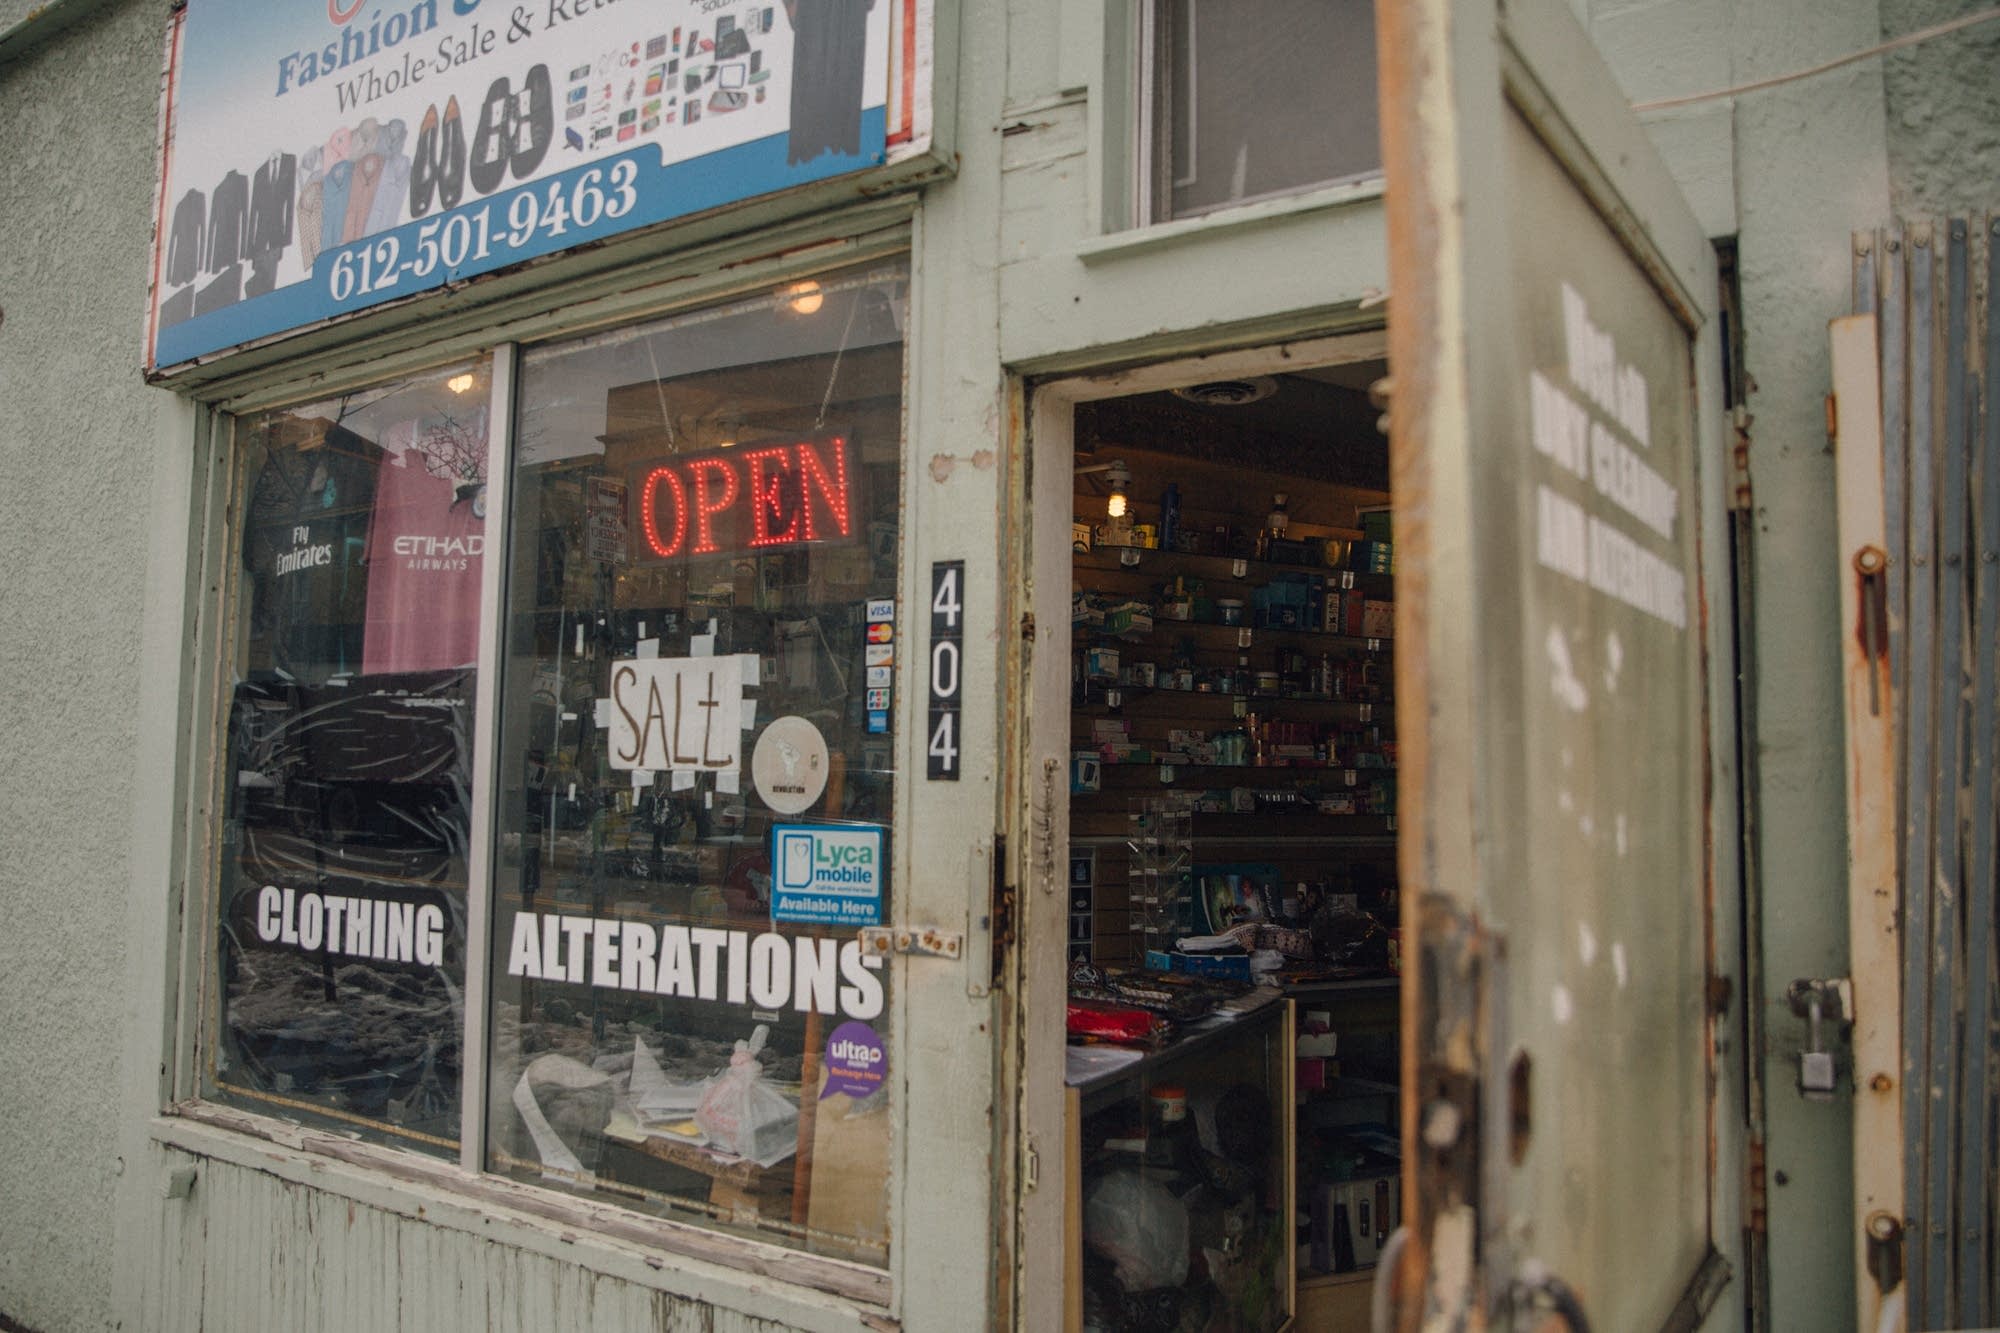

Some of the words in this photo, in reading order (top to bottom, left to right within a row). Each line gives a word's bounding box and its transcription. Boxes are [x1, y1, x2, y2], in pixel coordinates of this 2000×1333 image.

[275, 0, 438, 97] Fashion
[335, 23, 496, 114] Whole-Sale
[507, 6, 534, 43] &
[330, 158, 638, 301] 612-501-9463
[642, 436, 850, 557] OPEN
[276, 543, 332, 576] Emirates
[293, 525, 310, 545] Fly
[394, 535, 485, 556] ETIHAD
[407, 559, 468, 571] AIRWAYS
[870, 605, 892, 617] VISA
[929, 568, 961, 771] 404
[613, 666, 733, 768] SALE
[816, 838, 873, 868] Lyca
[816, 866, 873, 884] mobile
[258, 885, 444, 967] CLOTHING
[779, 896, 840, 914] Available
[842, 900, 876, 916] Here
[507, 911, 884, 1020] ALTERATIONS
